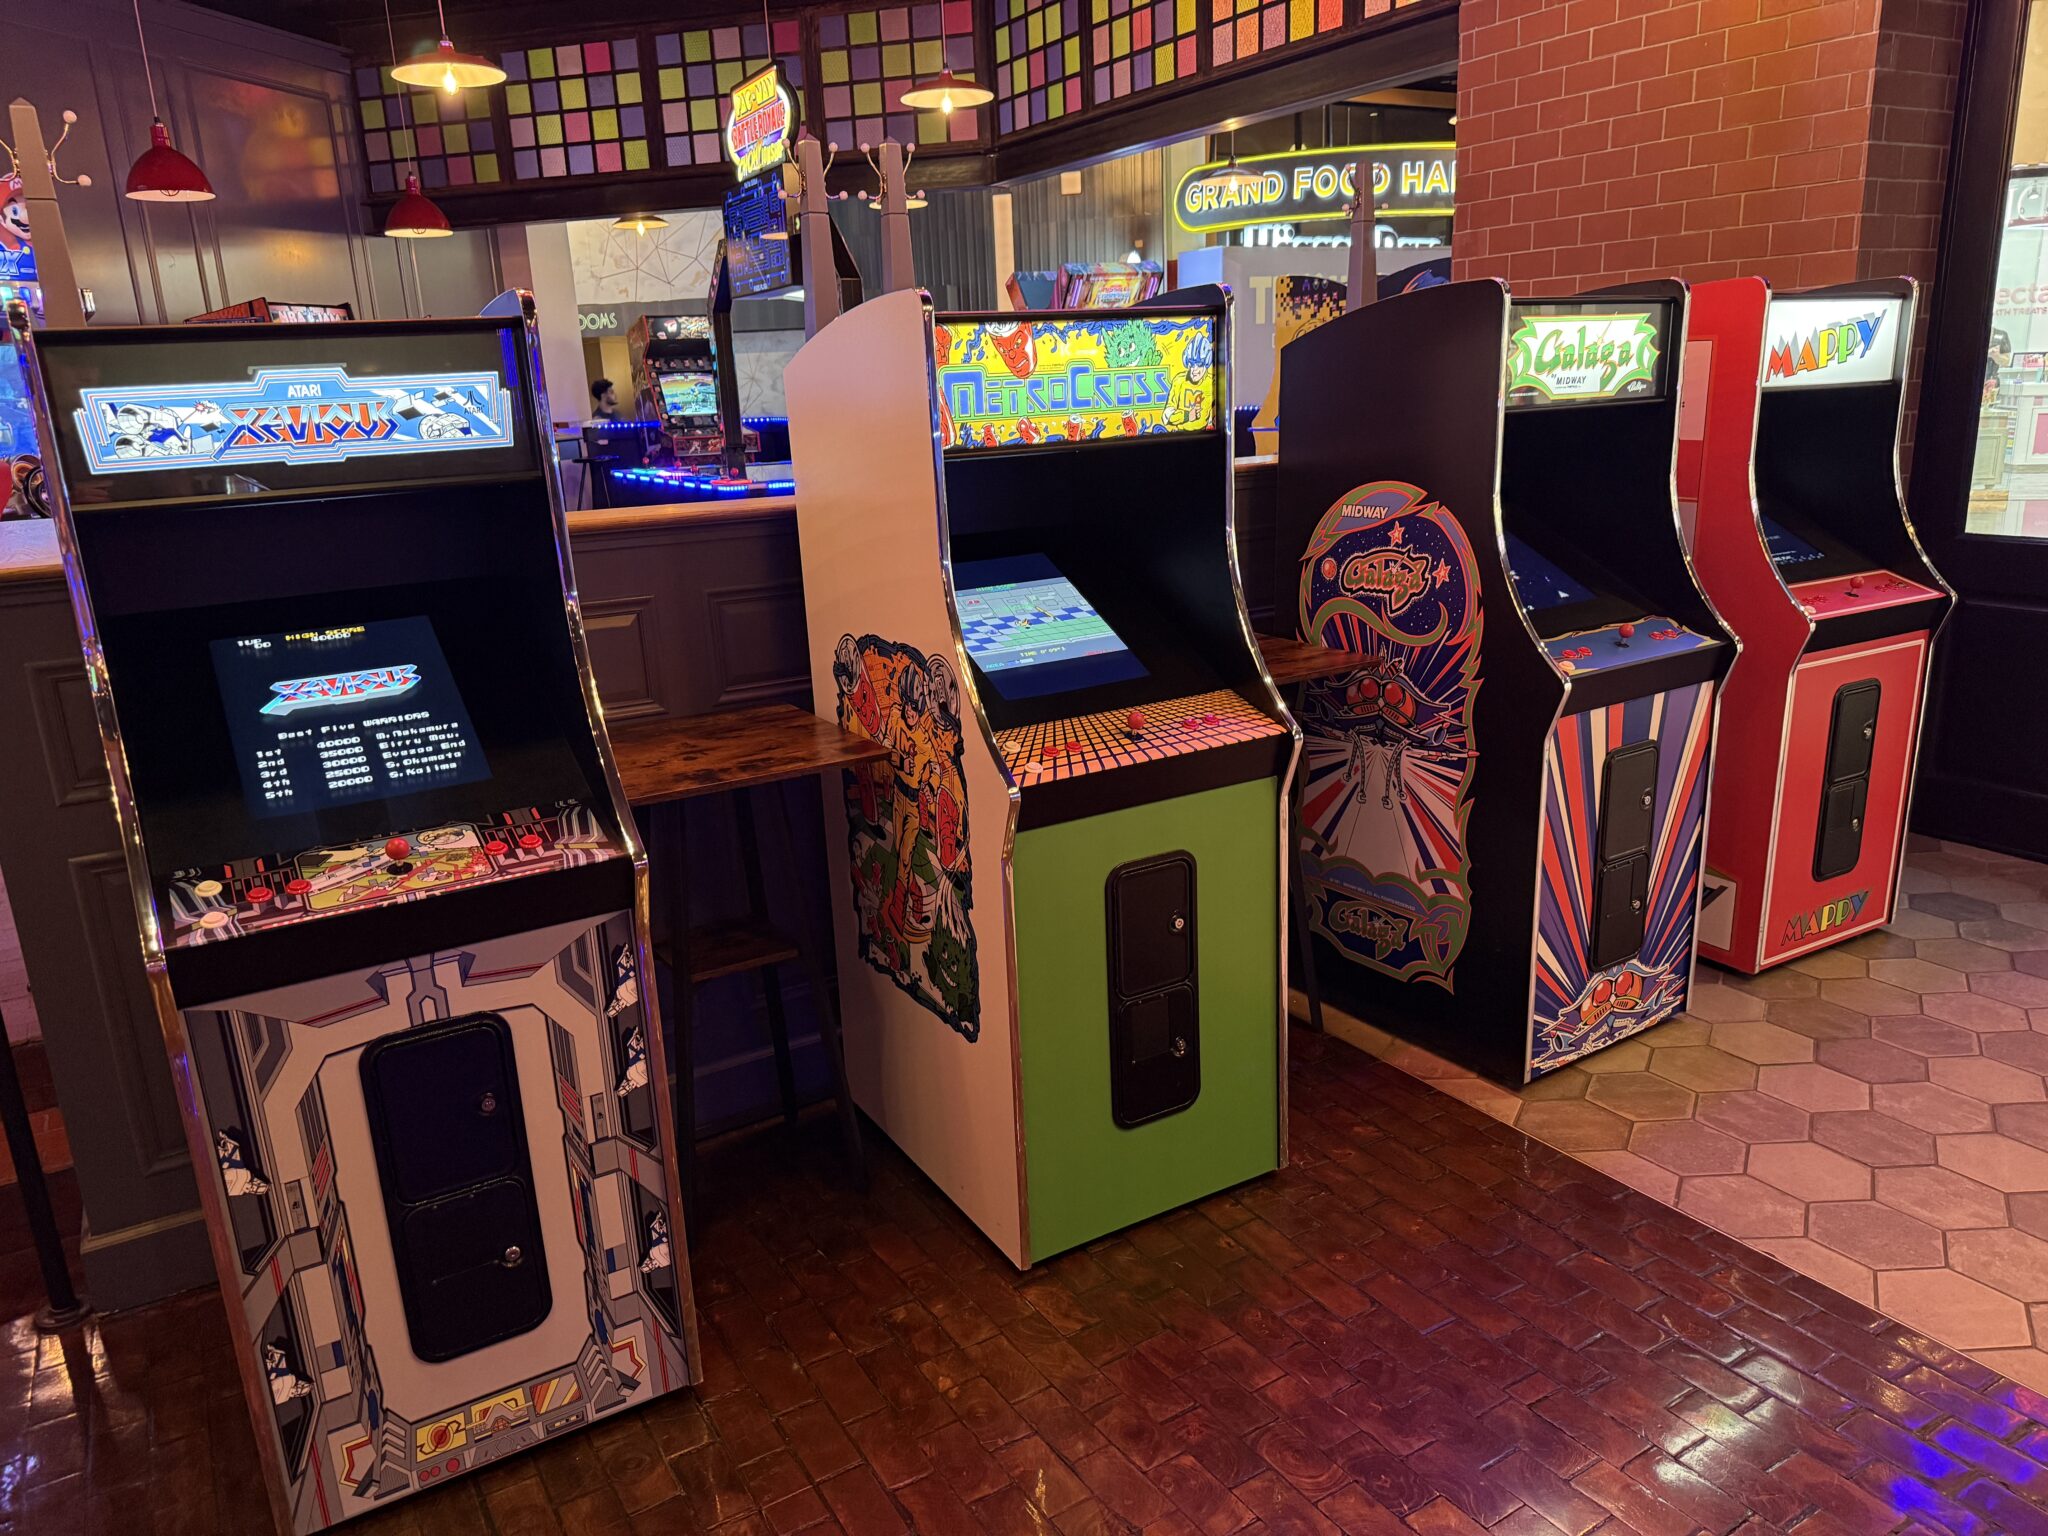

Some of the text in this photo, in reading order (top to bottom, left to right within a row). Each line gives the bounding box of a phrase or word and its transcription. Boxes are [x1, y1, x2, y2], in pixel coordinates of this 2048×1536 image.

[731, 117, 758, 151] BATTLE
[1185, 170, 1284, 213] GRAND
[1401, 160, 1456, 195] HA
[1534, 325, 1634, 392] Galaga
[1765, 316, 1881, 383] MAPPY
[287, 383, 322, 398] ATARI
[1556, 375, 1587, 386] MIDWAY
[463, 404, 485, 415] ATARI
[211, 400, 401, 462] XEVIOUS
[1341, 504, 1389, 519] MIDWAY
[1343, 554, 1427, 610] Galaga
[285, 626, 365, 641] HIGH SCORE
[259, 663, 421, 714] XEVIOUS
[320, 723, 355, 734] Five
[362, 711, 430, 727] WARRIORS
[257, 758, 285, 768] 2nd
[319, 745, 364, 759] 35000
[316, 736, 361, 749] 40000
[259, 768, 288, 778] 3rd
[322, 755, 367, 769] 30000
[440, 739, 466, 750] End
[262, 778, 291, 789] 4th
[325, 765, 370, 779] 25000
[264, 788, 293, 799] 5th
[328, 775, 374, 789] 20000
[1328, 900, 1408, 960] Galaga
[1781, 891, 1869, 946] MAPPY
